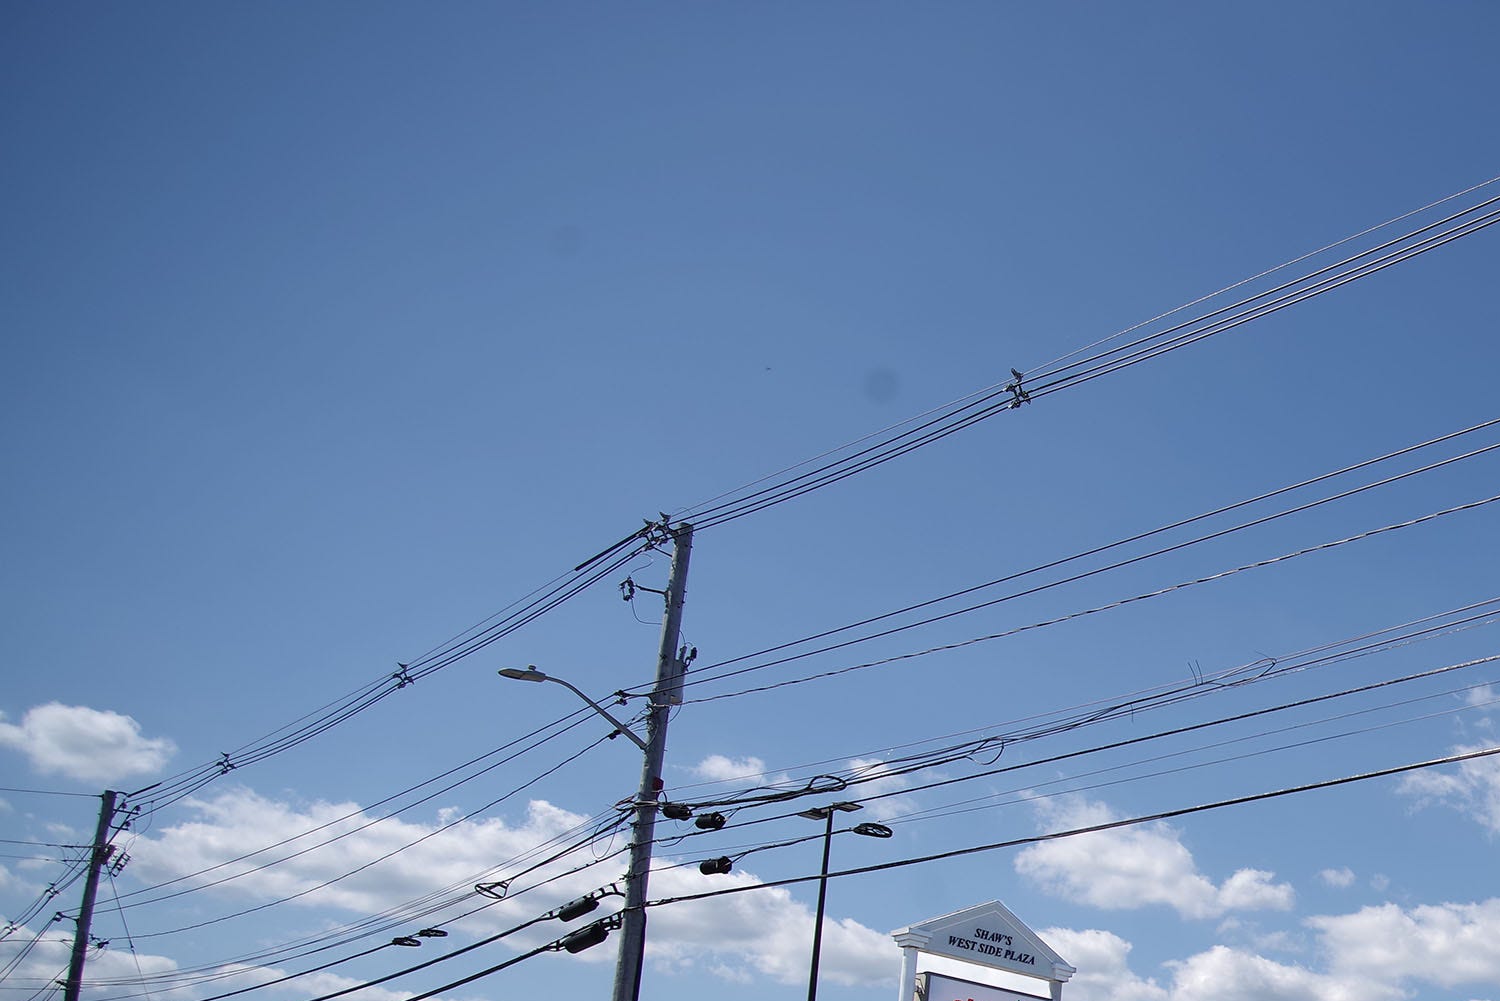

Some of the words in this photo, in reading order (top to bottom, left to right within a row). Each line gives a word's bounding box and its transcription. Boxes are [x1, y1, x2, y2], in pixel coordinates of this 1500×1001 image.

[974, 928, 1013, 946] SHAW'S
[948, 935, 977, 952] WEST
[977, 943, 1003, 957] SIDE
[1004, 949, 1035, 966] PLAZA
